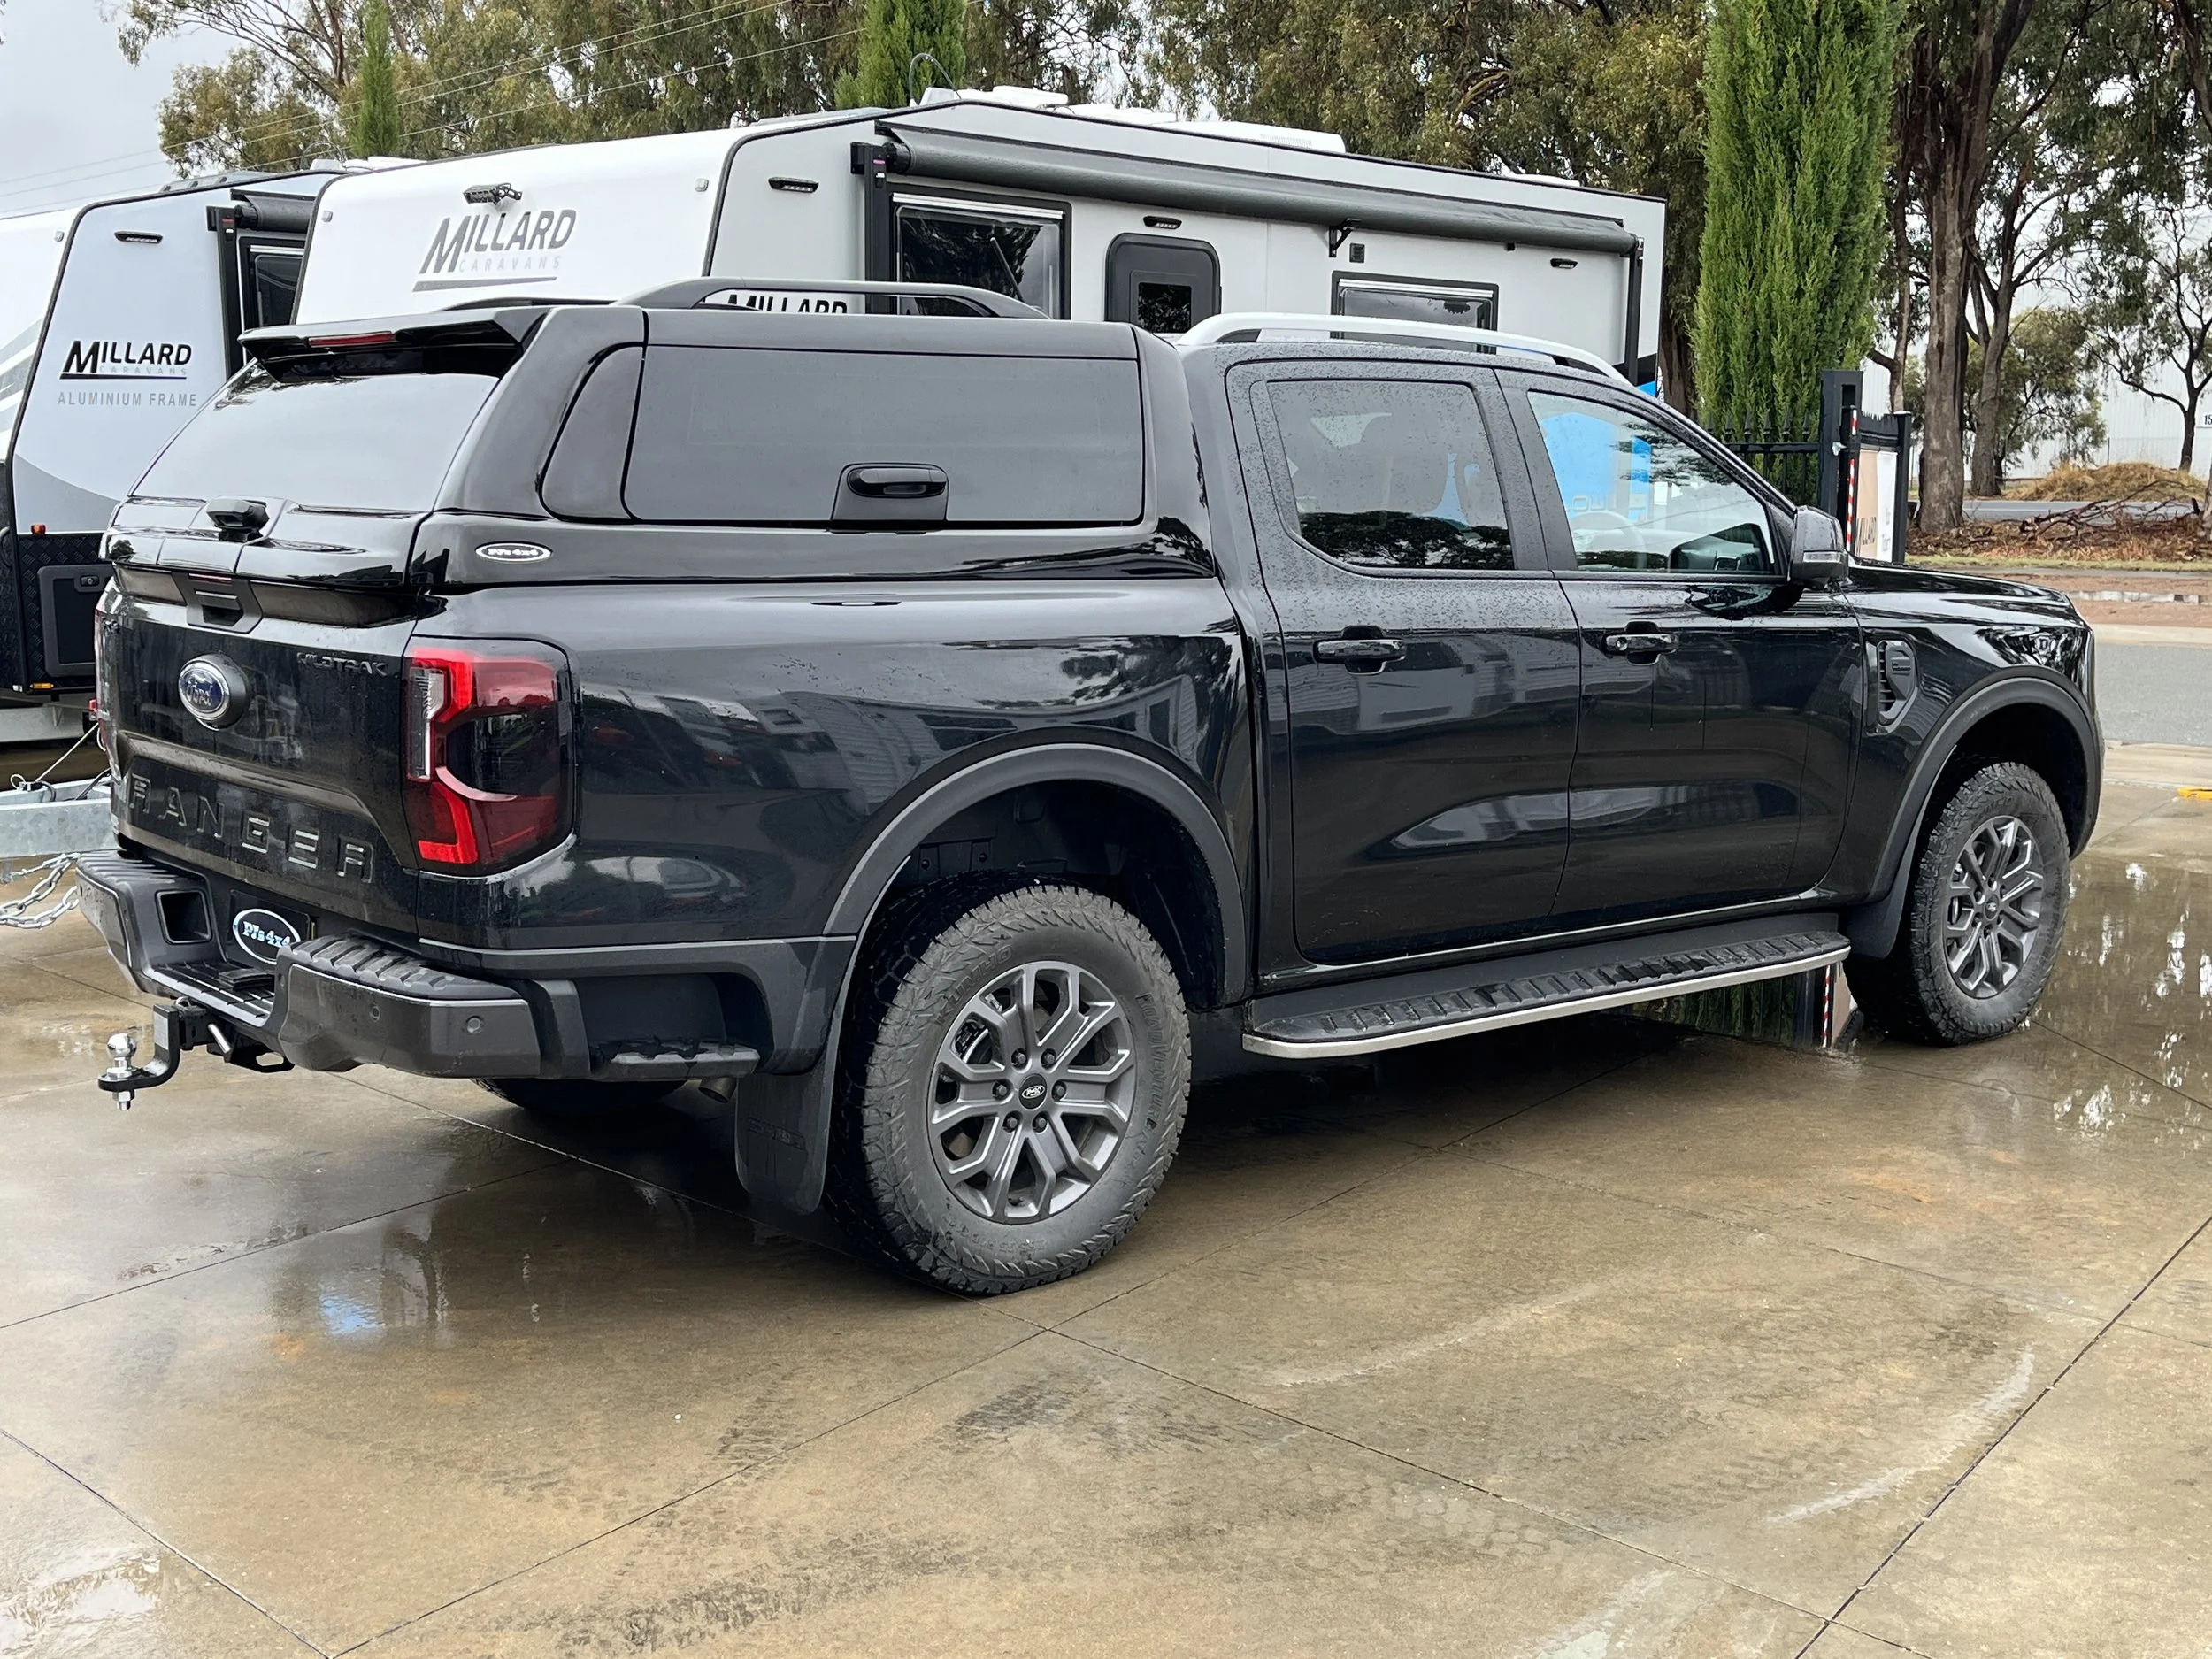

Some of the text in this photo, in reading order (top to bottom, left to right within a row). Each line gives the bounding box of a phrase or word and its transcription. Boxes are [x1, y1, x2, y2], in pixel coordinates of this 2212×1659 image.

[419, 209, 577, 274] MILLARD
[459, 256, 562, 273] CARAVANS
[62, 340, 192, 373] MILLARD
[100, 365, 187, 375] CARAVANS
[58, 392, 196, 407] ALUMINIUM FRAME
[129, 772, 374, 884] RANGER
[265, 930, 291, 949] 4x4
